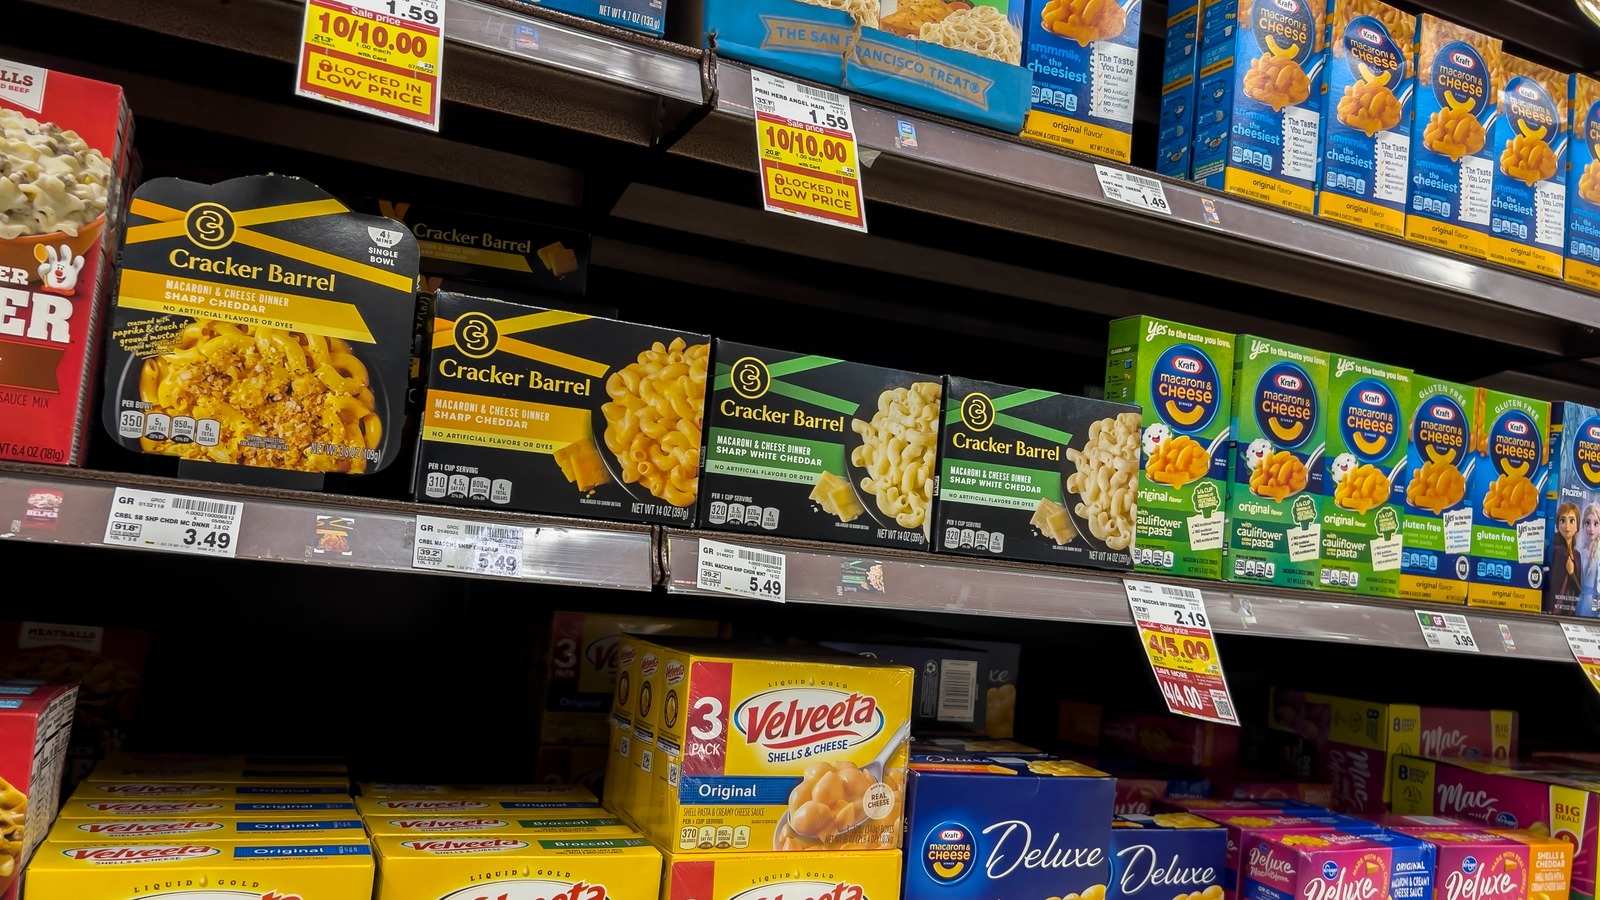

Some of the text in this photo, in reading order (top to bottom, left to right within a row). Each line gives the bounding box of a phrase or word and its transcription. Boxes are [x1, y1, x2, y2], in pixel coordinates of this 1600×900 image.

[351, 6, 401, 26] Sale price
[386, 0, 439, 24] 1.59
[319, 12, 428, 58] 10/10.00
[776, 26, 807, 42] THE
[809, 29, 840, 46] SAN
[1030, 42, 1081, 63] smmmile,
[1099, 53, 1135, 66] The Taste
[1101, 63, 1133, 75] You Love
[335, 64, 421, 93] LOCKED IN
[8, 84, 30, 93] BEEF
[316, 71, 422, 106] LOW PRICE
[771, 92, 788, 100] HERB
[789, 97, 809, 106] ANGEL
[809, 110, 848, 130] 1.59
[1249, 122, 1260, 130] the
[1052, 121, 1103, 139] original flavor
[1232, 123, 1280, 145] cheesiest
[766, 126, 847, 163] 10/10.00
[1327, 148, 1373, 170] cheesiest
[786, 177, 849, 198] LOCKED IN
[1413, 173, 1458, 193] cheesiest
[774, 185, 853, 210] LOW PRICE
[1142, 194, 1167, 209] 1.49
[368, 246, 399, 258] SINGLE
[1510, 247, 1531, 256] original
[370, 256, 396, 266] BOWL
[169, 248, 336, 292] Cracker Barrel
[164, 291, 266, 314] SHARP CHEDDAR
[163, 304, 176, 312] NO
[178, 307, 222, 320] ARTIFICIAL
[224, 314, 259, 324] FLAVORS
[274, 321, 294, 329] DYES
[113, 326, 145, 339] paprika
[155, 322, 177, 332] touch
[179, 320, 188, 328] of
[1145, 321, 1231, 348] Yes to the taste you love.
[438, 358, 591, 397] Cracker Barrel
[1280, 378, 1296, 388] Kraft
[1419, 384, 1467, 407] GLUTEN FREE
[435, 399, 550, 422] MACARONI & CHEESE DINNER
[720, 399, 844, 432] Cracker Barrel
[1435, 409, 1450, 419] Kraft
[1494, 400, 1539, 422] GLUTEN FREE
[122, 414, 142, 427] 350
[11, 445, 64, 462] 6.4 OZ (181g)
[428, 462, 439, 470] PER
[456, 466, 478, 474] SERVING
[429, 476, 445, 487] 310
[950, 475, 1041, 494] SHARP WHITE CHEDDAR
[1562, 488, 1582, 497] FROZEN
[118, 497, 135, 505] GR
[115, 512, 132, 520] CRBL
[631, 502, 644, 514] NET
[645, 504, 655, 514] WT
[656, 505, 663, 515] 14
[664, 506, 672, 517] OZ
[672, 506, 689, 520] (397g)
[421, 524, 434, 532] GR
[946, 529, 959, 540] 320
[1148, 527, 1172, 537] pasta
[1236, 527, 1283, 541] cauliflower
[183, 528, 230, 549] 3.49
[1476, 530, 1515, 542] gluten free
[1251, 538, 1274, 550] pasta
[1322, 538, 1366, 552] cauliflower
[478, 553, 517, 572] 5.49
[1174, 610, 1206, 627] 2.19
[1433, 615, 1443, 625] GF
[29, 628, 95, 639] MEATBALLS
[1453, 634, 1474, 647] 3.99
[1149, 635, 1210, 662] 4/5.00
[1155, 666, 1188, 678] SAVE MORE
[768, 678, 848, 689] LIQUID GOLD
[1163, 681, 1203, 710] 4/4.00
[690, 695, 724, 740] 3
[745, 691, 877, 745] Velveeta
[692, 743, 721, 755] PACK
[867, 797, 890, 808] CHEESE
[871, 791, 887, 800] REAL
[1438, 782, 1499, 812] Mac
[683, 807, 696, 817] SHELL
[697, 807, 711, 817] PASTA
[716, 808, 733, 817] CREAMY
[734, 807, 750, 817] CHEESE
[751, 807, 765, 817] SAUCE
[1555, 803, 1580, 817] BIG
[254, 822, 320, 830] Original
[1555, 814, 1579, 824] DEAL!
[682, 828, 697, 838] 370
[254, 846, 325, 855] Original
[554, 839, 614, 847] Broccoli
[982, 820, 1104, 880] Deluxe
[73, 844, 222, 861] Velveeta
[1116, 843, 1217, 895] Deluxe
[1396, 861, 1425, 871] ORIGINAL
[133, 879, 260, 894] LIQUID GOLD
